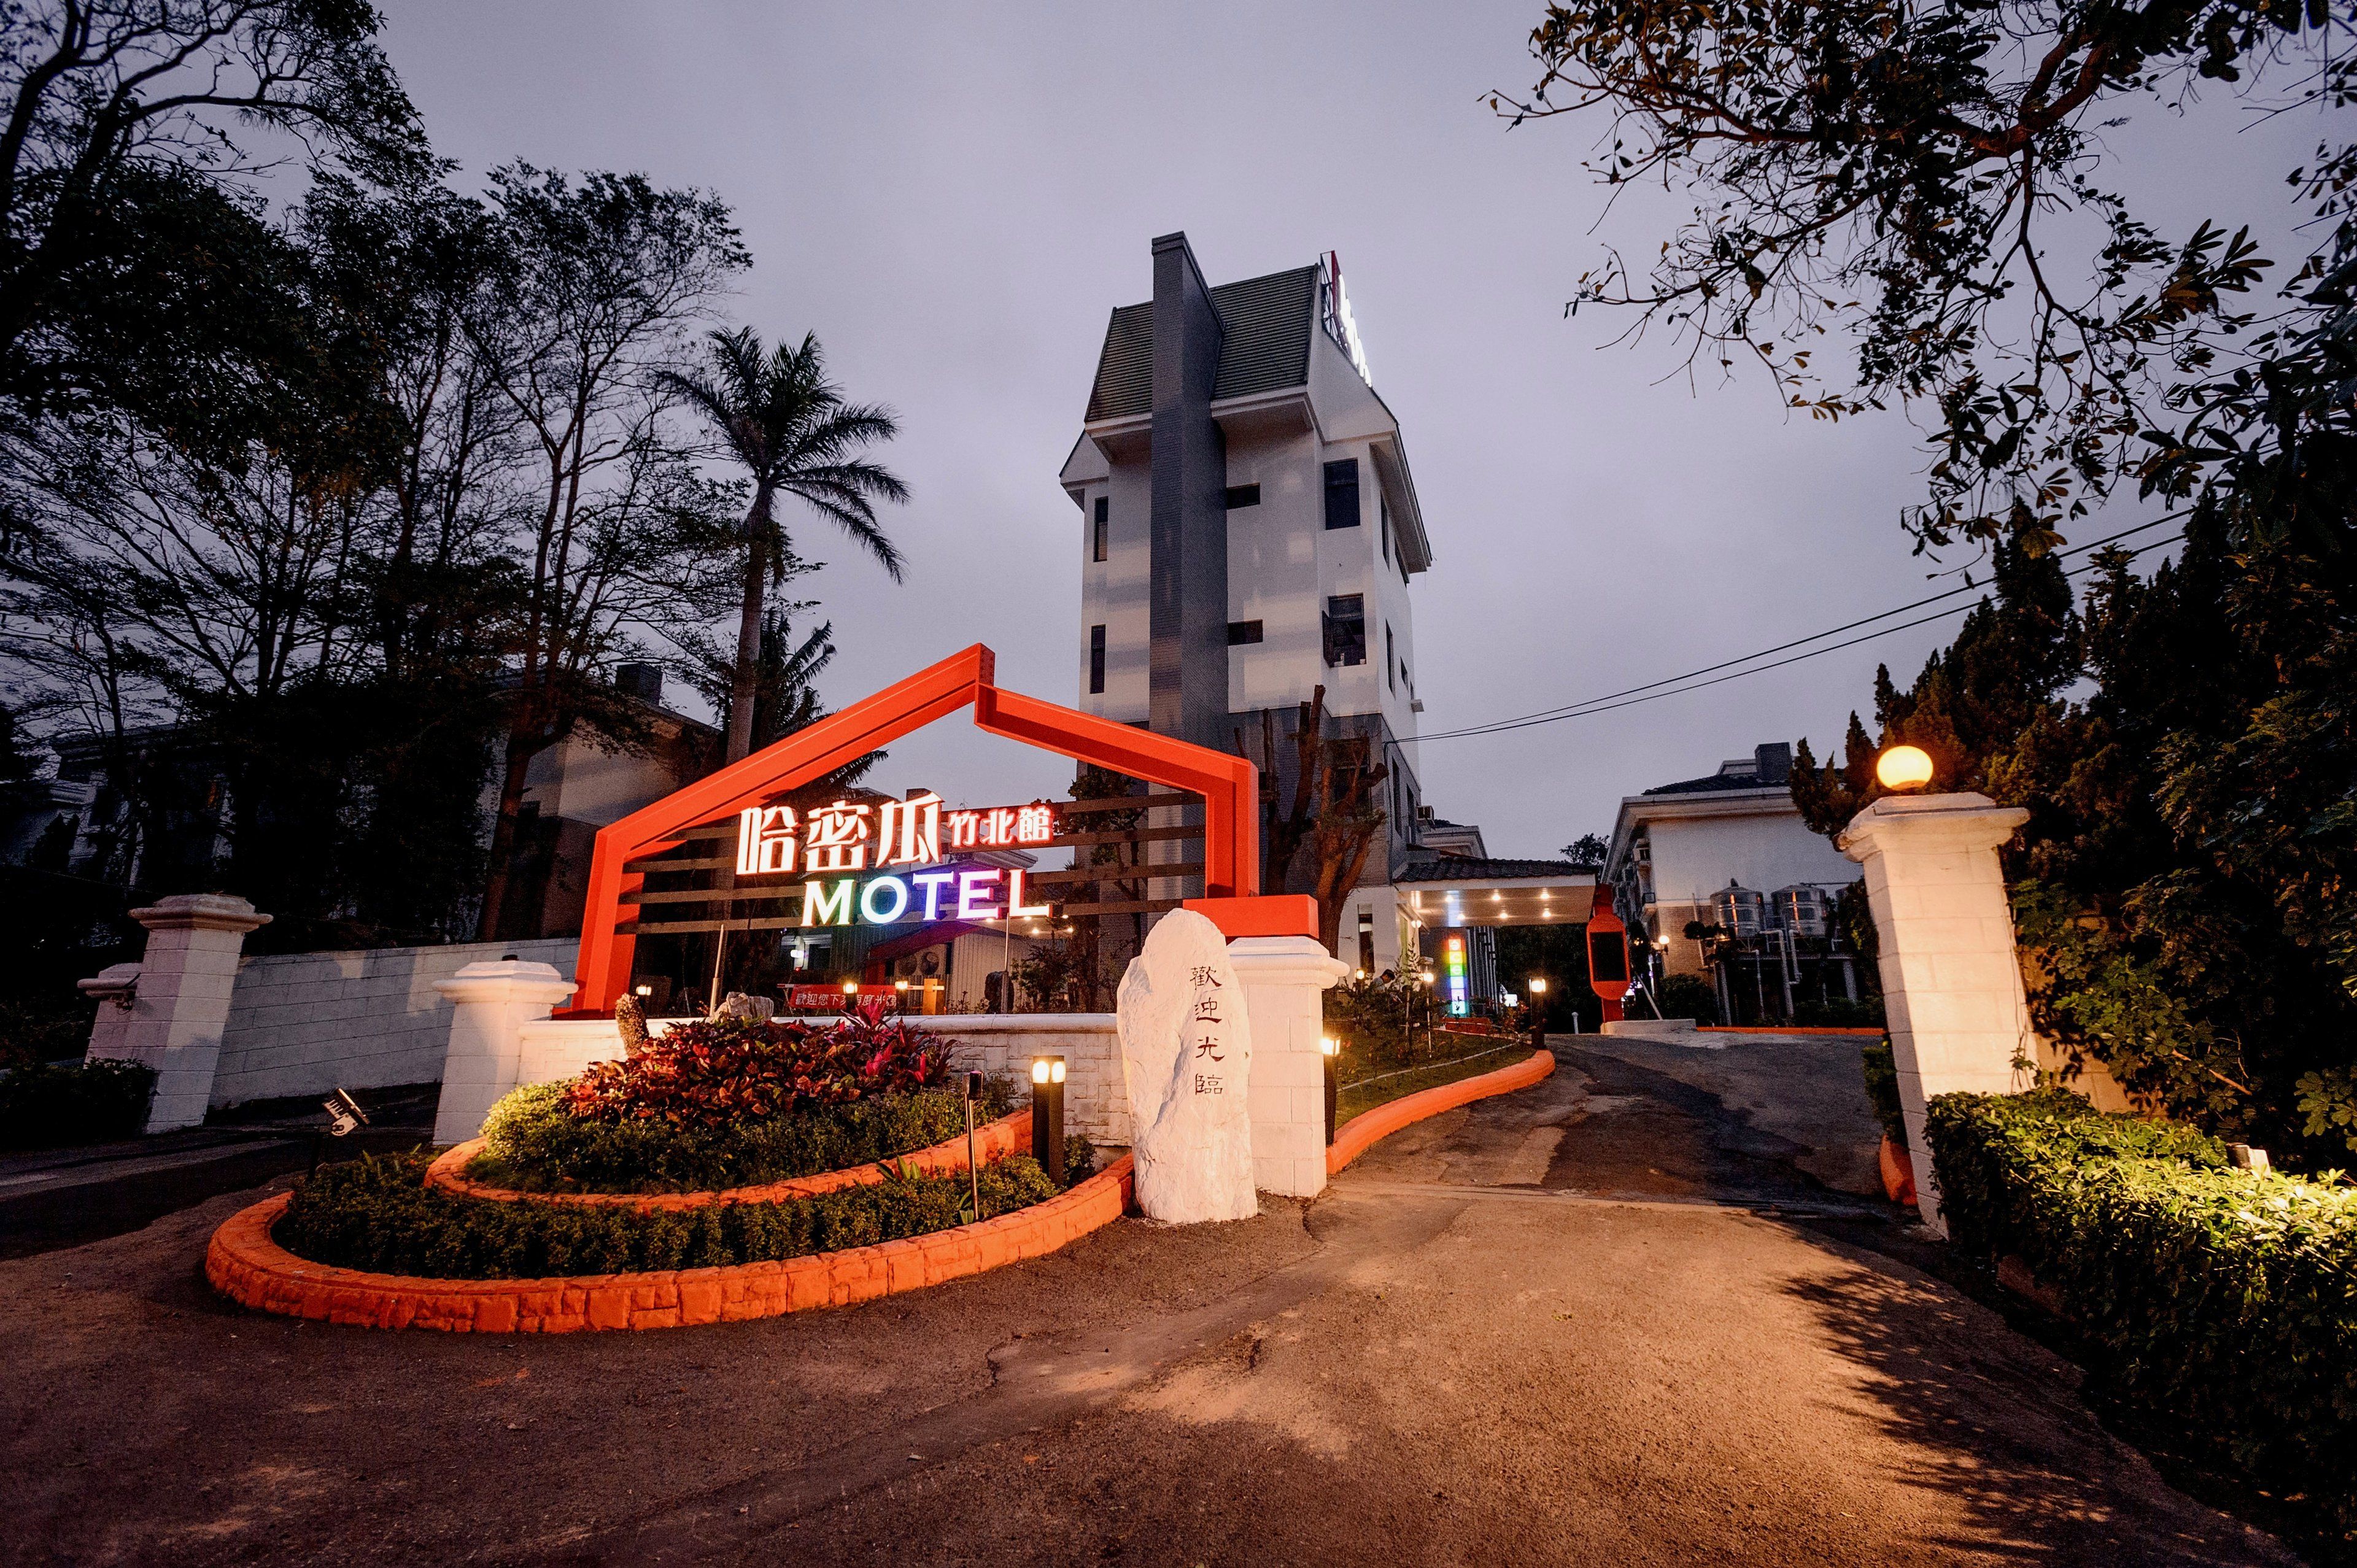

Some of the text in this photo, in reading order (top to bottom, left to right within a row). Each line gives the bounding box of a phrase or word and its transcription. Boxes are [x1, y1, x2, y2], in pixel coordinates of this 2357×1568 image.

[735, 791, 1051, 875] 哈密瓜 竹北館
[800, 868, 1051, 927] MOTEL
[1190, 966, 1225, 1095] 歡迎光臨
